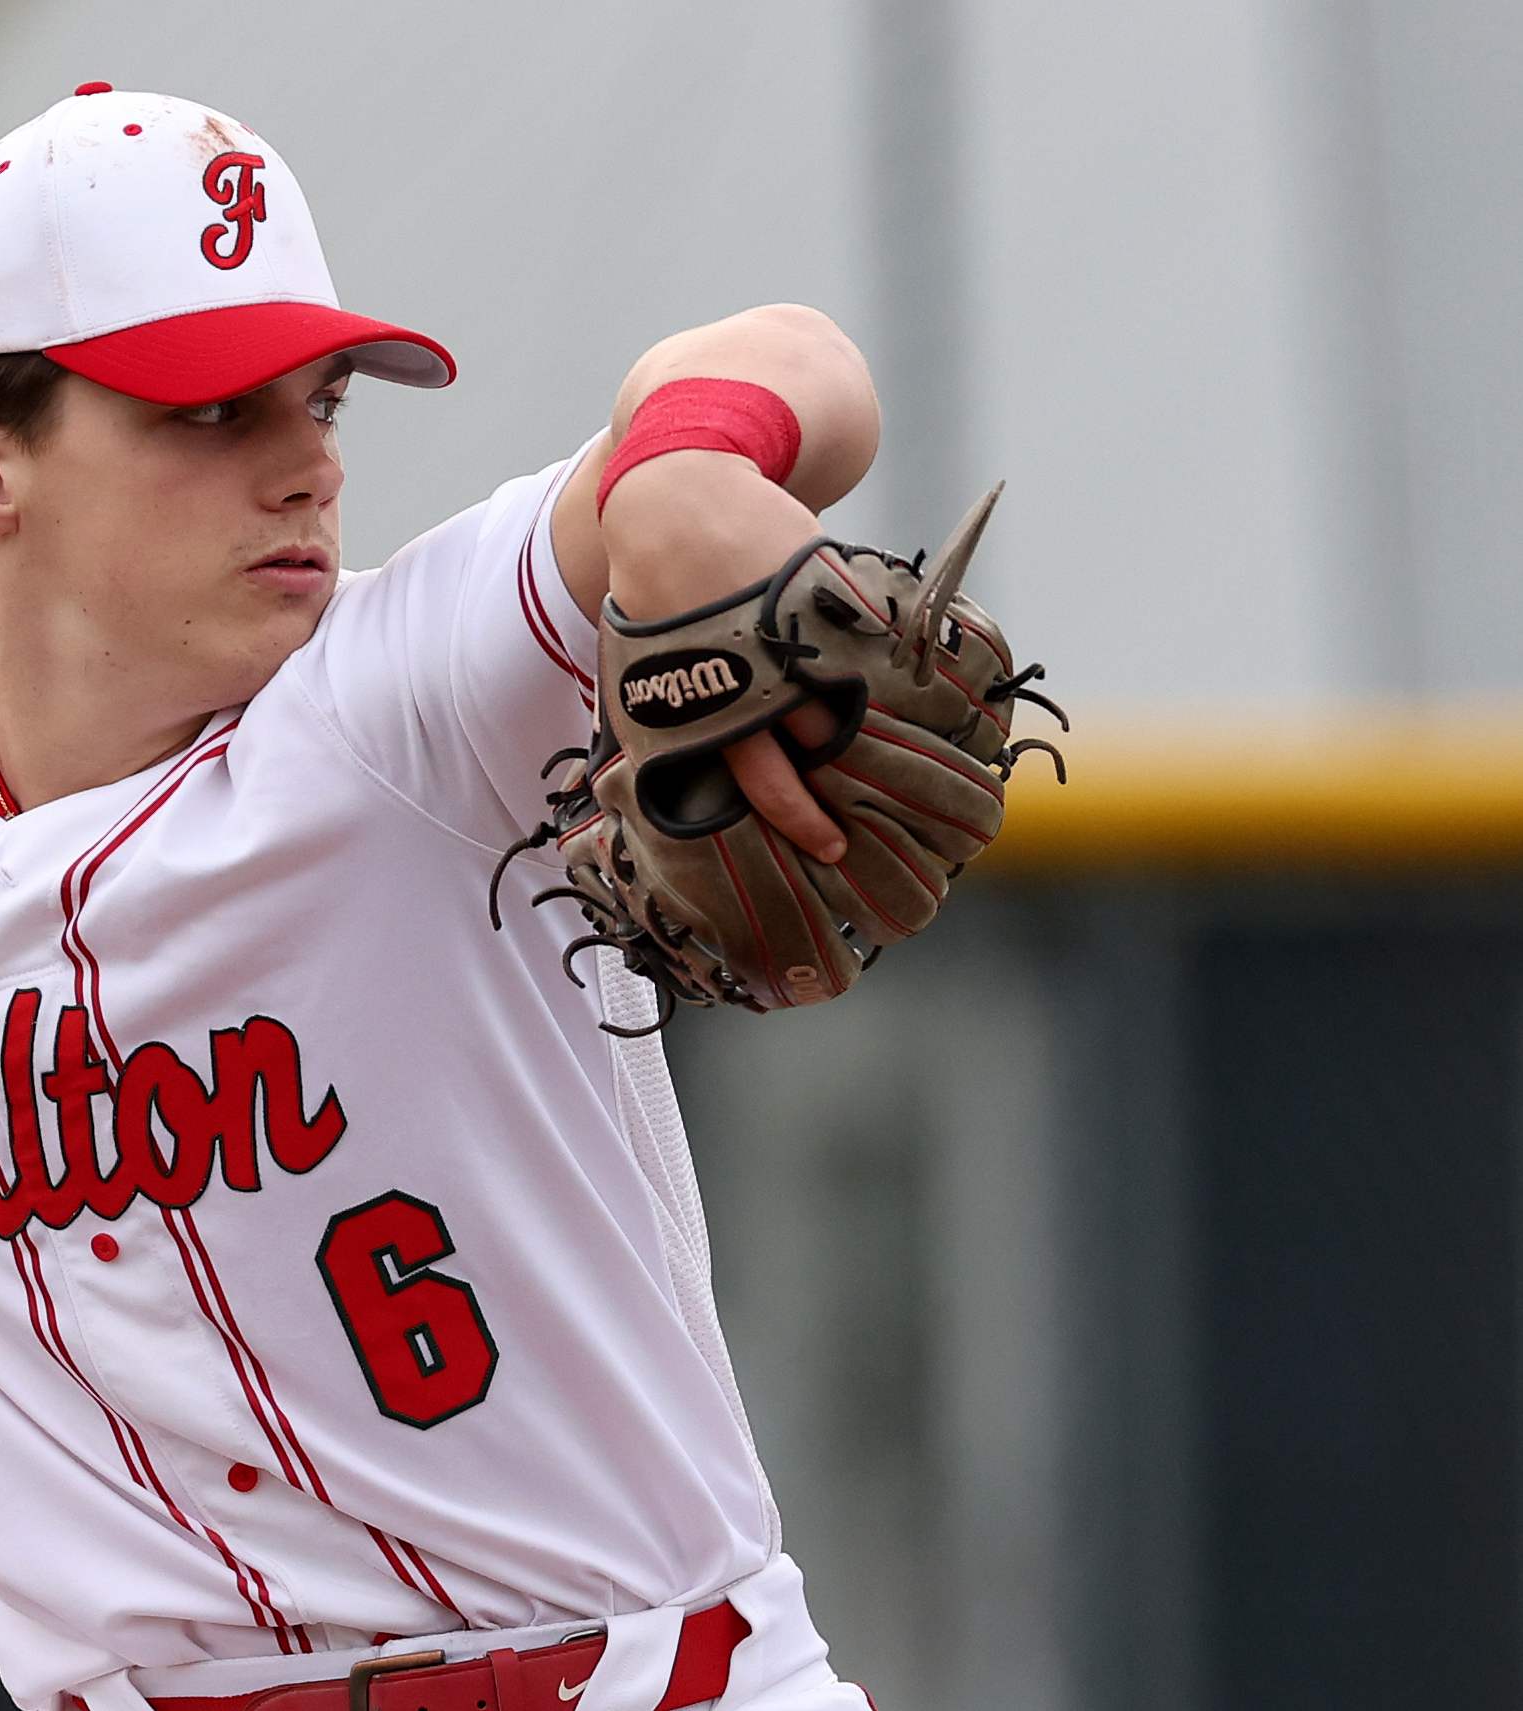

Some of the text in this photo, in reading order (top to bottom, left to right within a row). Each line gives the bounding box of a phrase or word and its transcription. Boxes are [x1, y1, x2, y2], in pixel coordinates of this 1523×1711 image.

[200, 151, 267, 270] F
[624, 657, 739, 709] Wilson
[315, 1189, 499, 1430] 6
